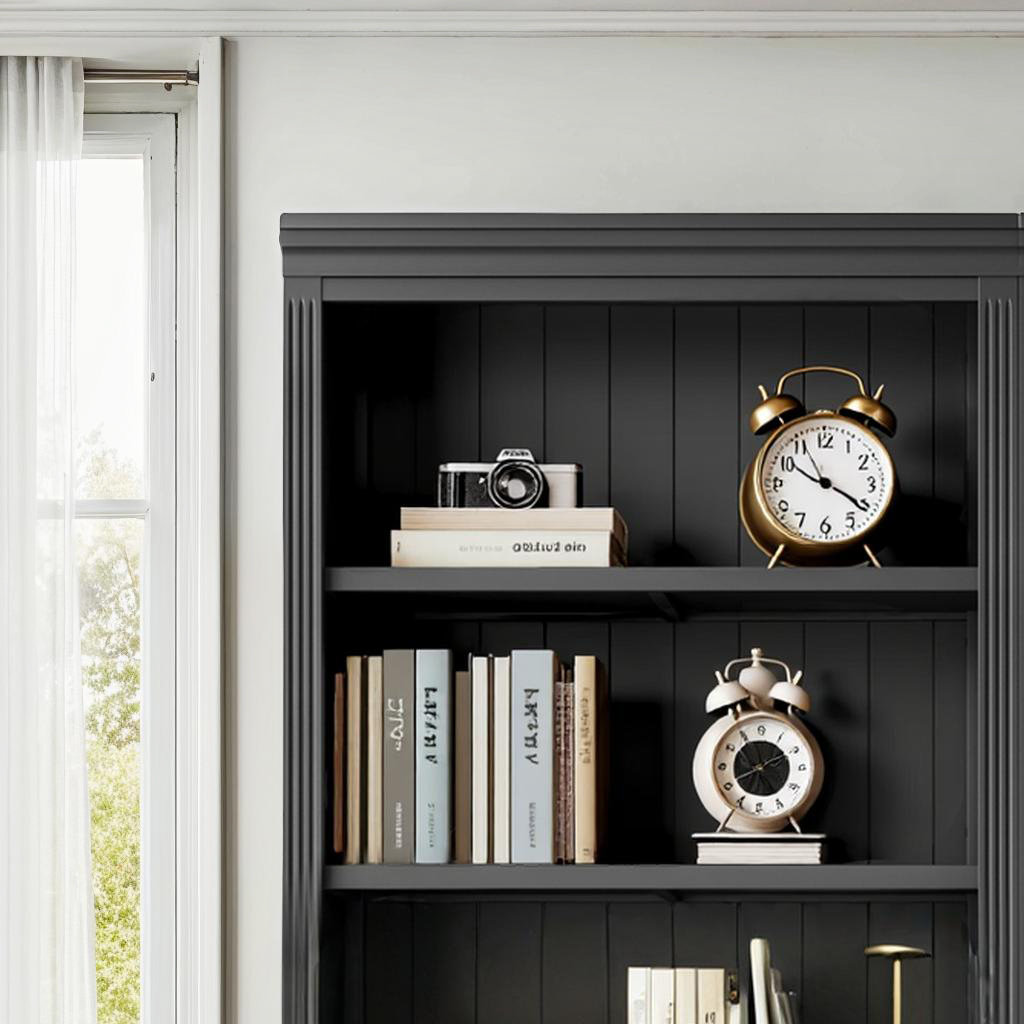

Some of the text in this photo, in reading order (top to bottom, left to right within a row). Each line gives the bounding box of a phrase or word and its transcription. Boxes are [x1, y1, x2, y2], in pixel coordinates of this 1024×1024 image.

[794, 439, 806, 455] 11
[817, 432, 834, 448] 12
[781, 456, 795, 472] 10
[858, 454, 869, 471] 2
[867, 476, 876, 493] 3
[795, 512, 806, 528] 7
[820, 516, 832, 534] 6
[845, 512, 855, 529] 5
